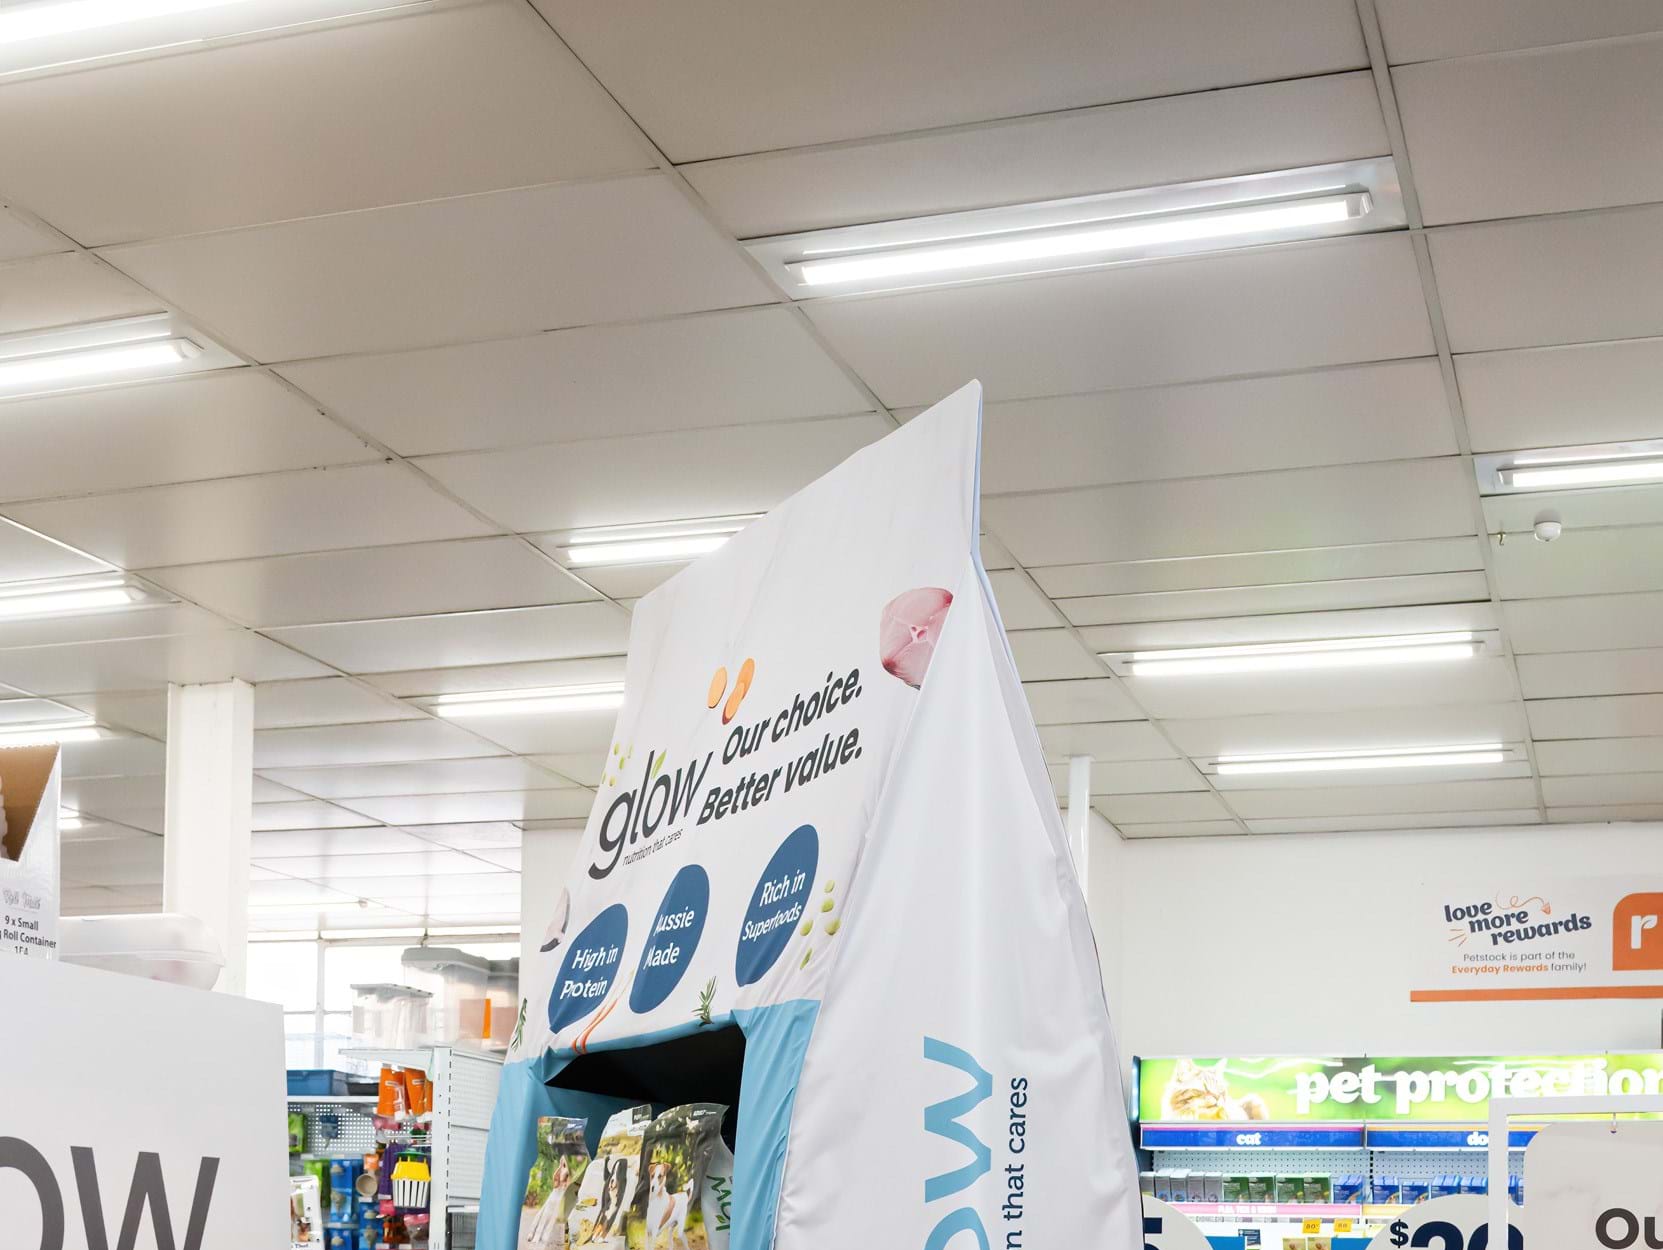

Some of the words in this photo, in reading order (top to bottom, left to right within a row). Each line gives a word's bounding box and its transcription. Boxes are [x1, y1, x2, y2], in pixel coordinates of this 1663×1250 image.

[722, 717, 771, 765] Our
[771, 668, 862, 744] choice.
[696, 752, 782, 826] Better
[784, 728, 862, 793] value.
[588, 750, 714, 879] glow
[760, 875, 790, 906] Rich
[791, 869, 805, 894] in
[5, 915, 10, 925] 9
[18, 917, 39, 931] Small
[742, 902, 801, 942] Superfoods
[1444, 902, 1493, 922] love
[1468, 910, 1528, 933] more
[4, 929, 19, 941] Roll
[20, 933, 57, 949] Container
[1491, 913, 1592, 945] rewards
[572, 947, 606, 971] High
[606, 944, 619, 964] in
[1452, 965, 1501, 976] Everyday
[1503, 963, 1549, 973] Rewards
[1551, 962, 1587, 973] family!
[1463, 951, 1506, 962] Petstock
[1510, 951, 1518, 960] is
[1520, 951, 1543, 963] part
[1545, 950, 1556, 960] of
[1558, 949, 1576, 960] the
[560, 977, 607, 999] Protein
[1291, 1064, 1382, 1114] pet
[1008, 1077, 1028, 1154] cares
[1236, 1132, 1262, 1145] cat
[1467, 1132, 1489, 1146] do
[1004, 1164, 1024, 1221] that
